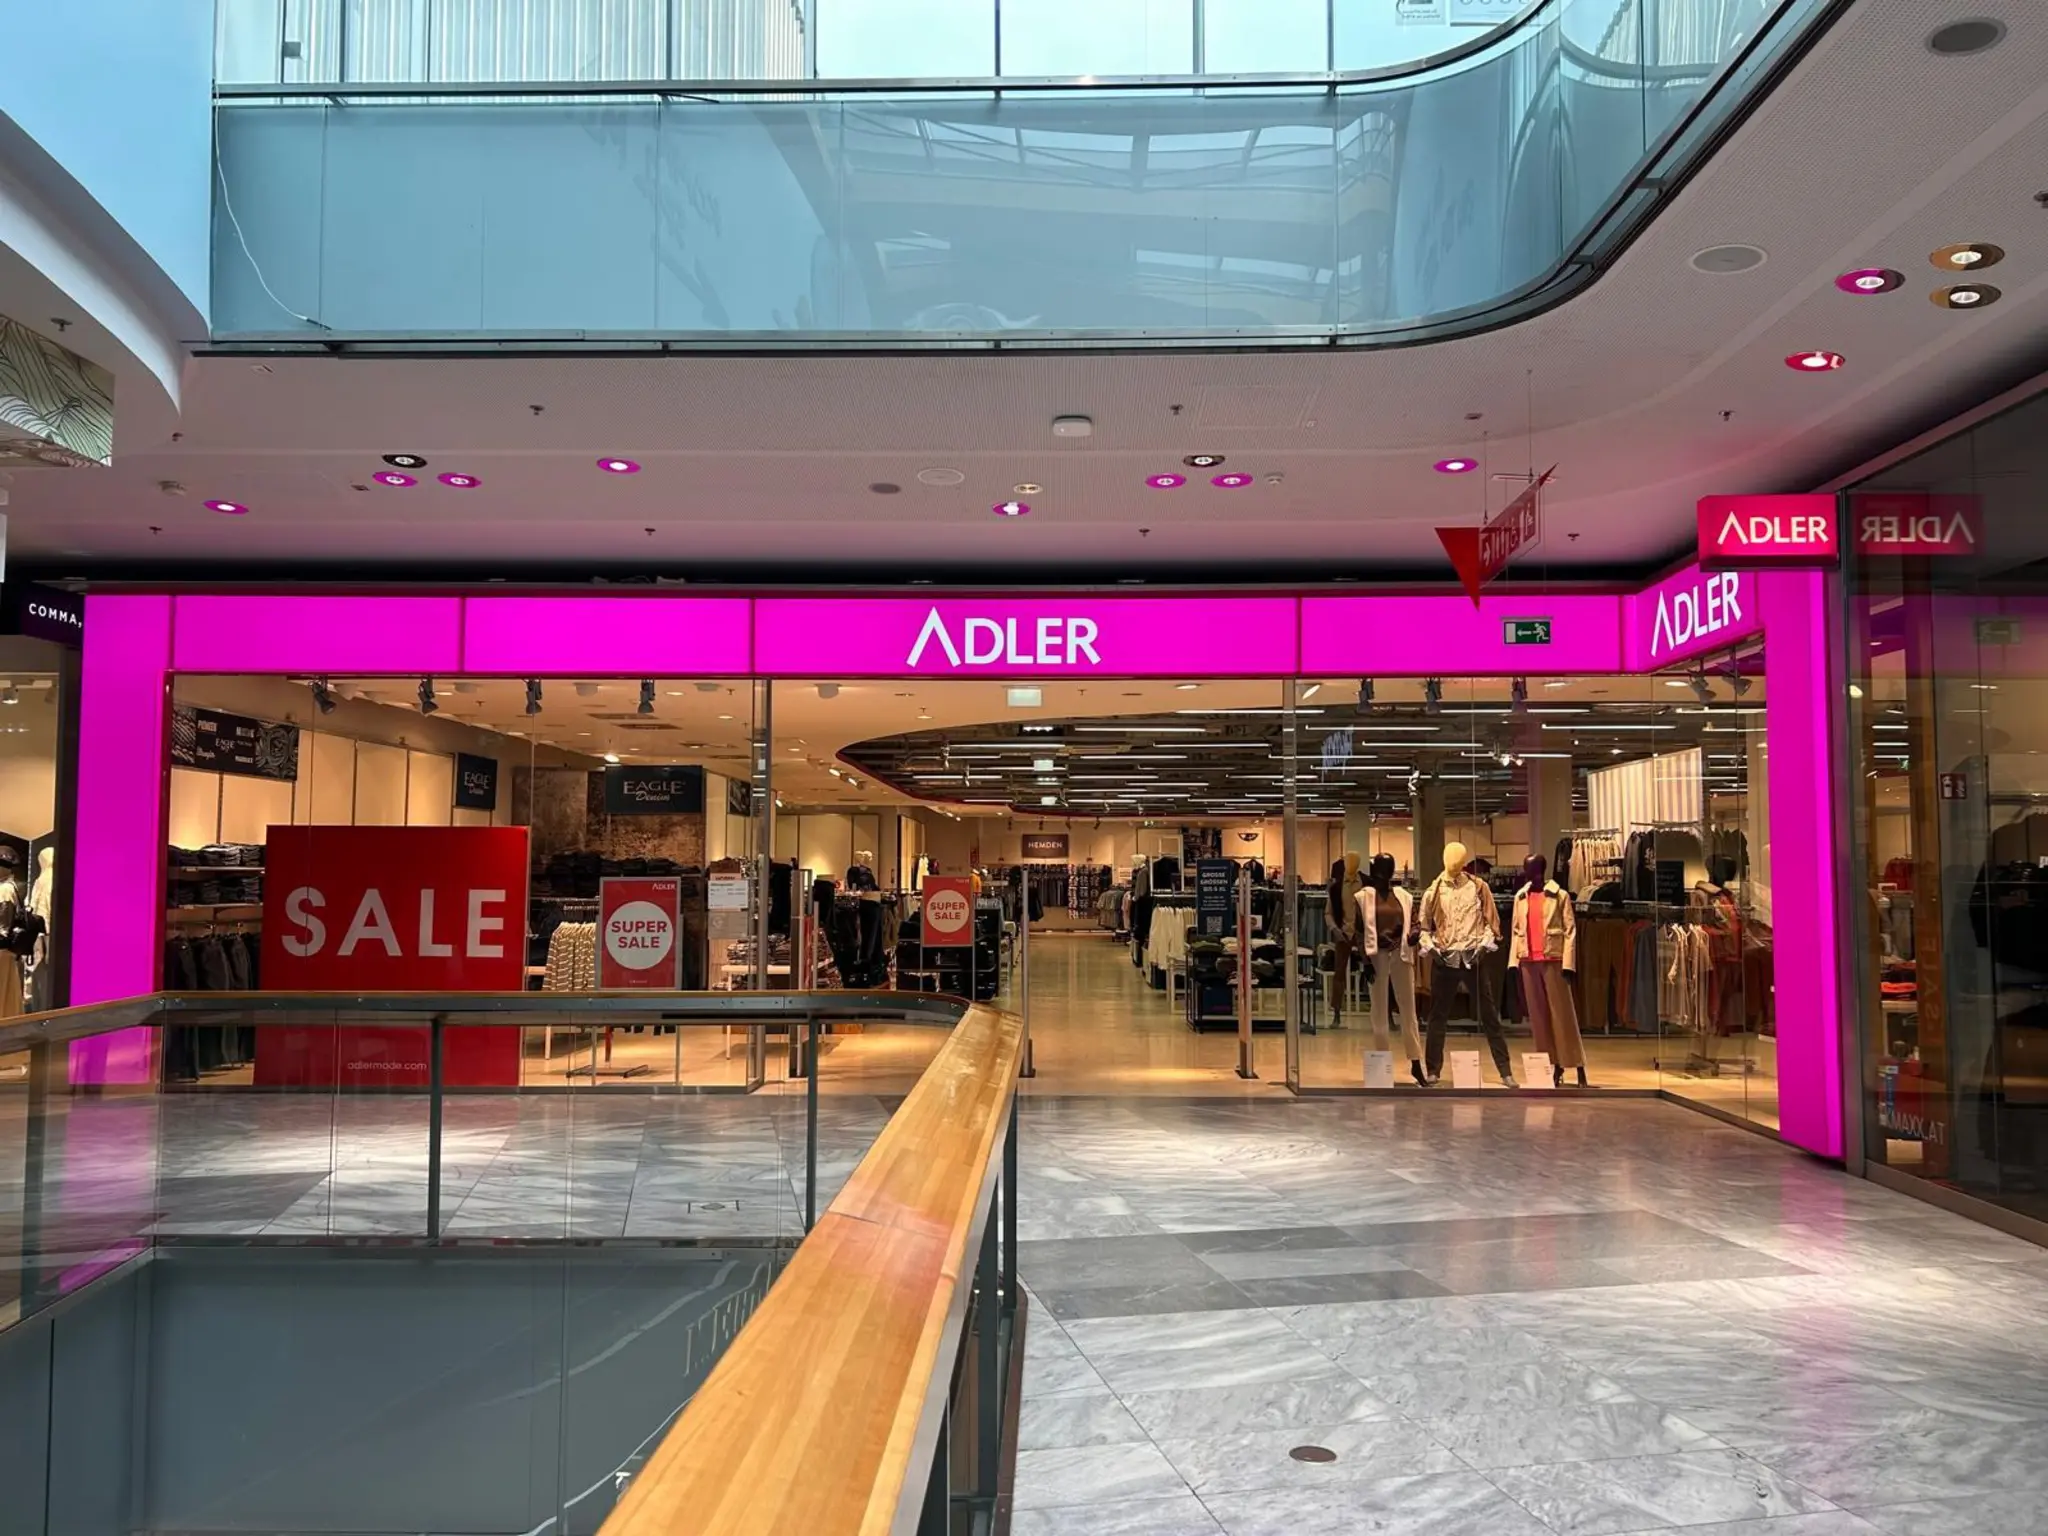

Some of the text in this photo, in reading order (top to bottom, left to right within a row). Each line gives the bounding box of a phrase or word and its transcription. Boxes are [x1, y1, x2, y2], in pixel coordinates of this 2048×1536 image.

[1717, 511, 1829, 544] ADLER
[28, 603, 83, 628] COMMA,
[1651, 571, 1742, 657] ADLER
[906, 606, 1101, 668] ADLER
[623, 781, 684, 795] EAGLE
[1028, 841, 1063, 849] HEMDEN
[652, 883, 676, 891] ADLER
[930, 902, 966, 911] SUPER
[934, 911, 961, 920] SALE
[281, 886, 506, 958] SALE
[611, 921, 668, 933] SUPER
[618, 937, 660, 949] SALE
[347, 1060, 428, 1071] adlermode.com
